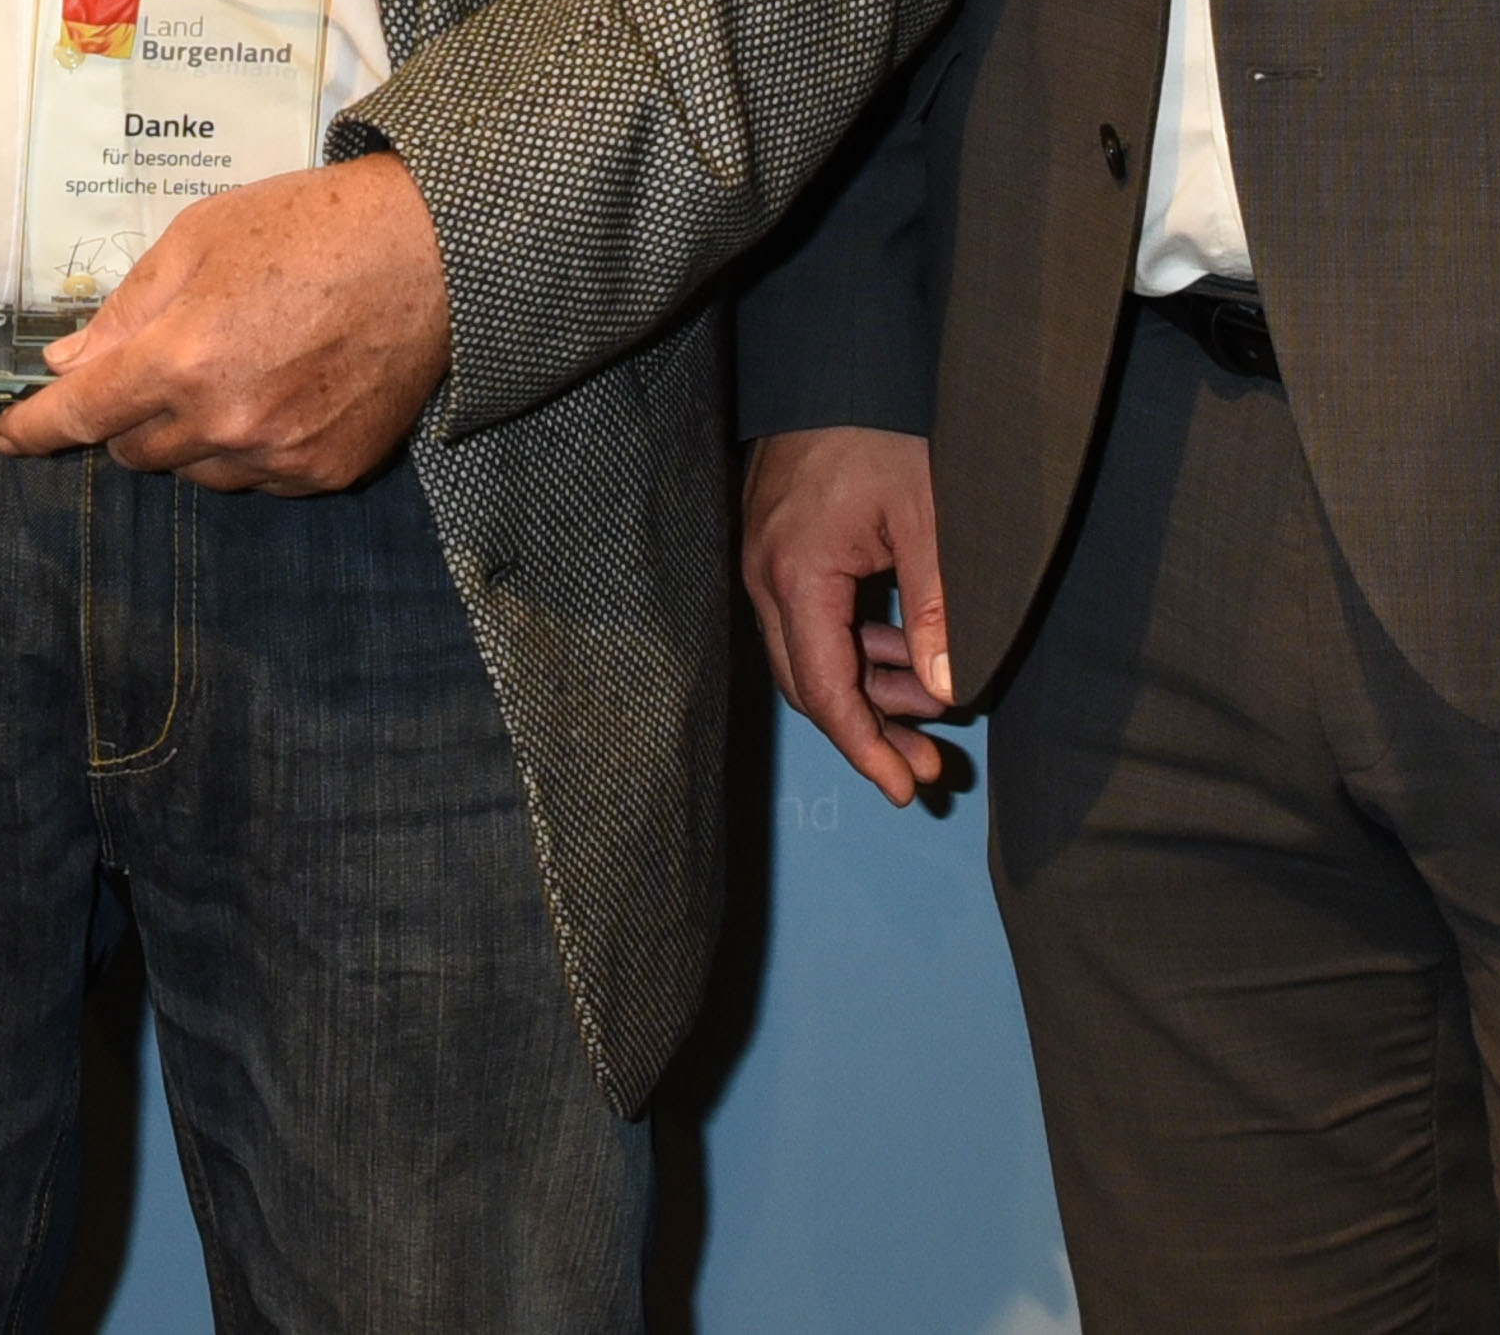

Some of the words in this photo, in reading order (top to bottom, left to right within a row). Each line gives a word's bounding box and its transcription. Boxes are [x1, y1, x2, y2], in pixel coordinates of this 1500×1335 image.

[143, 15, 204, 38] Land
[142, 40, 293, 68] Burgenland
[124, 113, 216, 138] Danke
[102, 148, 129, 166] für
[134, 148, 232, 168] besondere
[65, 178, 158, 197] sportliche
